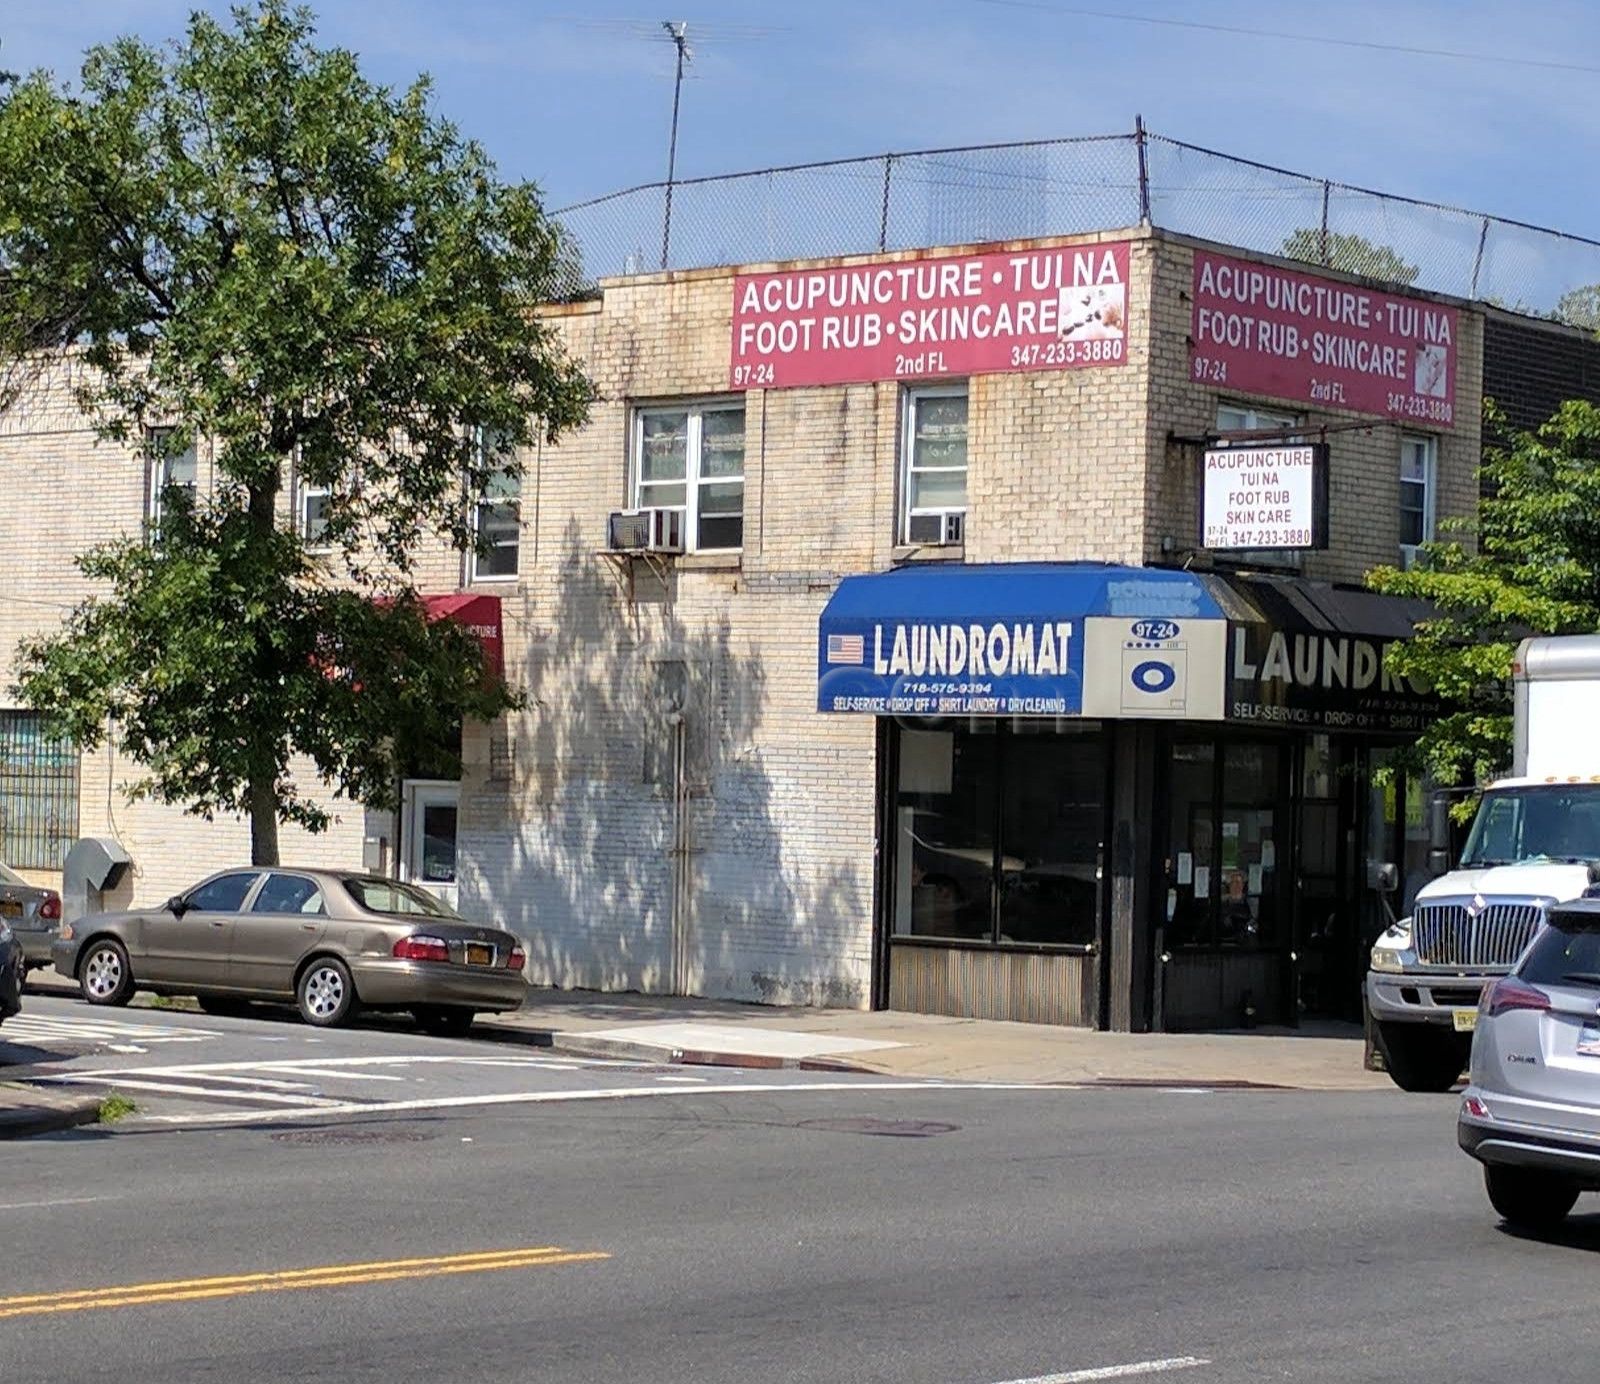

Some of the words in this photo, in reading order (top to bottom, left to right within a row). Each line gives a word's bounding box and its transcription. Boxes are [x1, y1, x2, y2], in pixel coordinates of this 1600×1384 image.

[740, 261, 984, 314] ACUPUNCTURE
[1010, 254, 1063, 292] TUI
[1073, 250, 1120, 285] NA
[1199, 261, 1370, 329] ACUPUNCTURE
[1386, 302, 1419, 338] TUI
[1424, 311, 1451, 345] NA
[739, 318, 825, 355] FOOT
[822, 313, 881, 349] RUB
[898, 299, 1058, 345] SKINCARE
[1011, 339, 1122, 366] 347-233-3880
[1198, 308, 1255, 350] FOOT
[1258, 320, 1299, 358] RUB
[1311, 331, 1407, 380] SKINCARE
[734, 364, 775, 386] 97-24
[895, 354, 925, 375] 2nd
[928, 352, 948, 372] FL
[1194, 357, 1227, 383] 97-24
[1310, 378, 1331, 400] 2nd
[1331, 382, 1346, 404] FL
[1386, 391, 1453, 422] 347-233-3880
[1207, 450, 1312, 469] ACUPUNCTURE
[1240, 472, 1260, 486] TUI
[1262, 471, 1279, 486] NA
[1228, 491, 1261, 506] FOOT
[1264, 490, 1290, 504] RUB
[1226, 510, 1255, 525] SKIN
[1258, 509, 1292, 524] CARE
[1232, 529, 1310, 546] 347-233-3880
[1136, 623, 1175, 638] 97-24
[874, 622, 1073, 677] LAUNDROMAT
[903, 682, 993, 694] 718-575-9394
[833, 695, 885, 712] SELF-SERVICE
[891, 697, 914, 712] DROP
[914, 697, 930, 712] OFF
[938, 697, 961, 712] SHIRT
[1008, 697, 1025, 712] DRY
[1025, 697, 1066, 713] CLEANING
[1233, 701, 1312, 722] SELF-SERVICE
[1324, 710, 1355, 727] DROP
